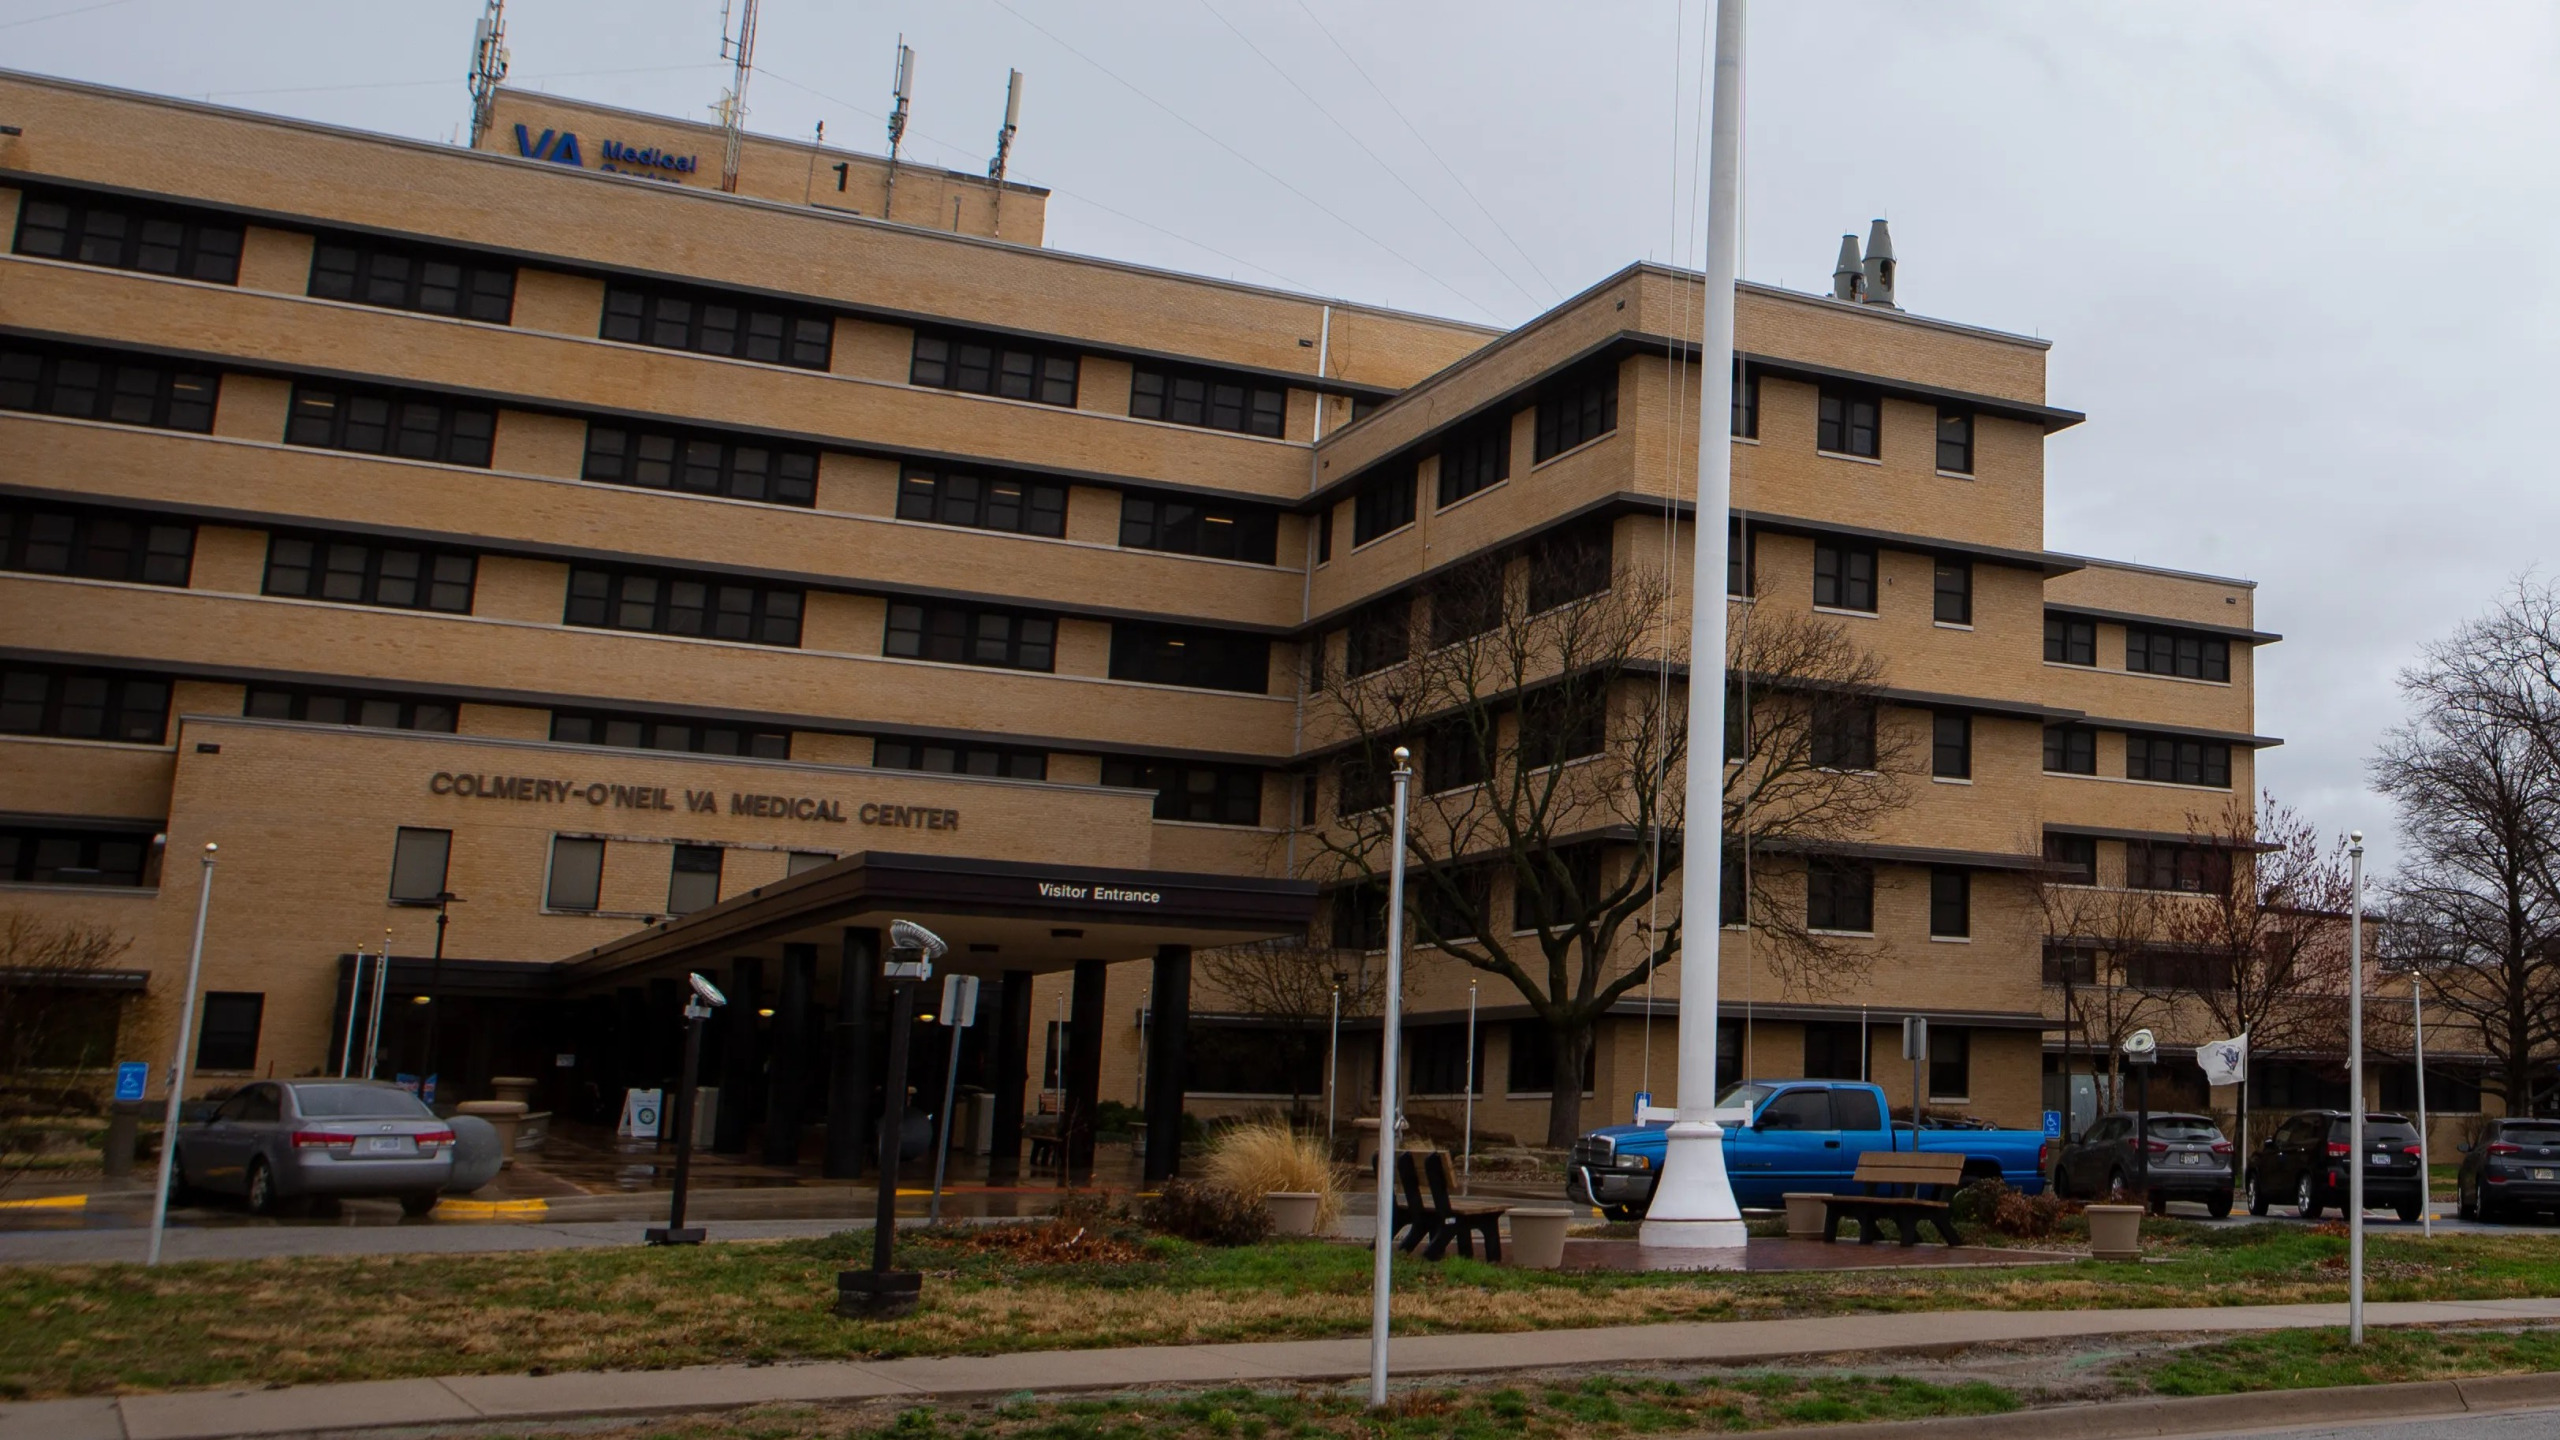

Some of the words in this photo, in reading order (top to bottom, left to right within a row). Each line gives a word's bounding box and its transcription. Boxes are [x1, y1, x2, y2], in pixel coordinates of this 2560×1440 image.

[514, 123, 584, 166] VA
[602, 139, 697, 173] Medical
[832, 161, 849, 192] 1
[430, 771, 675, 811] COLMERY-O'NEIL
[685, 789, 718, 814] VA
[731, 793, 847, 823] MEDICAL
[859, 803, 959, 831] CENTER
[1039, 882, 1087, 898] Visitor
[1094, 887, 1160, 903] Entrance
